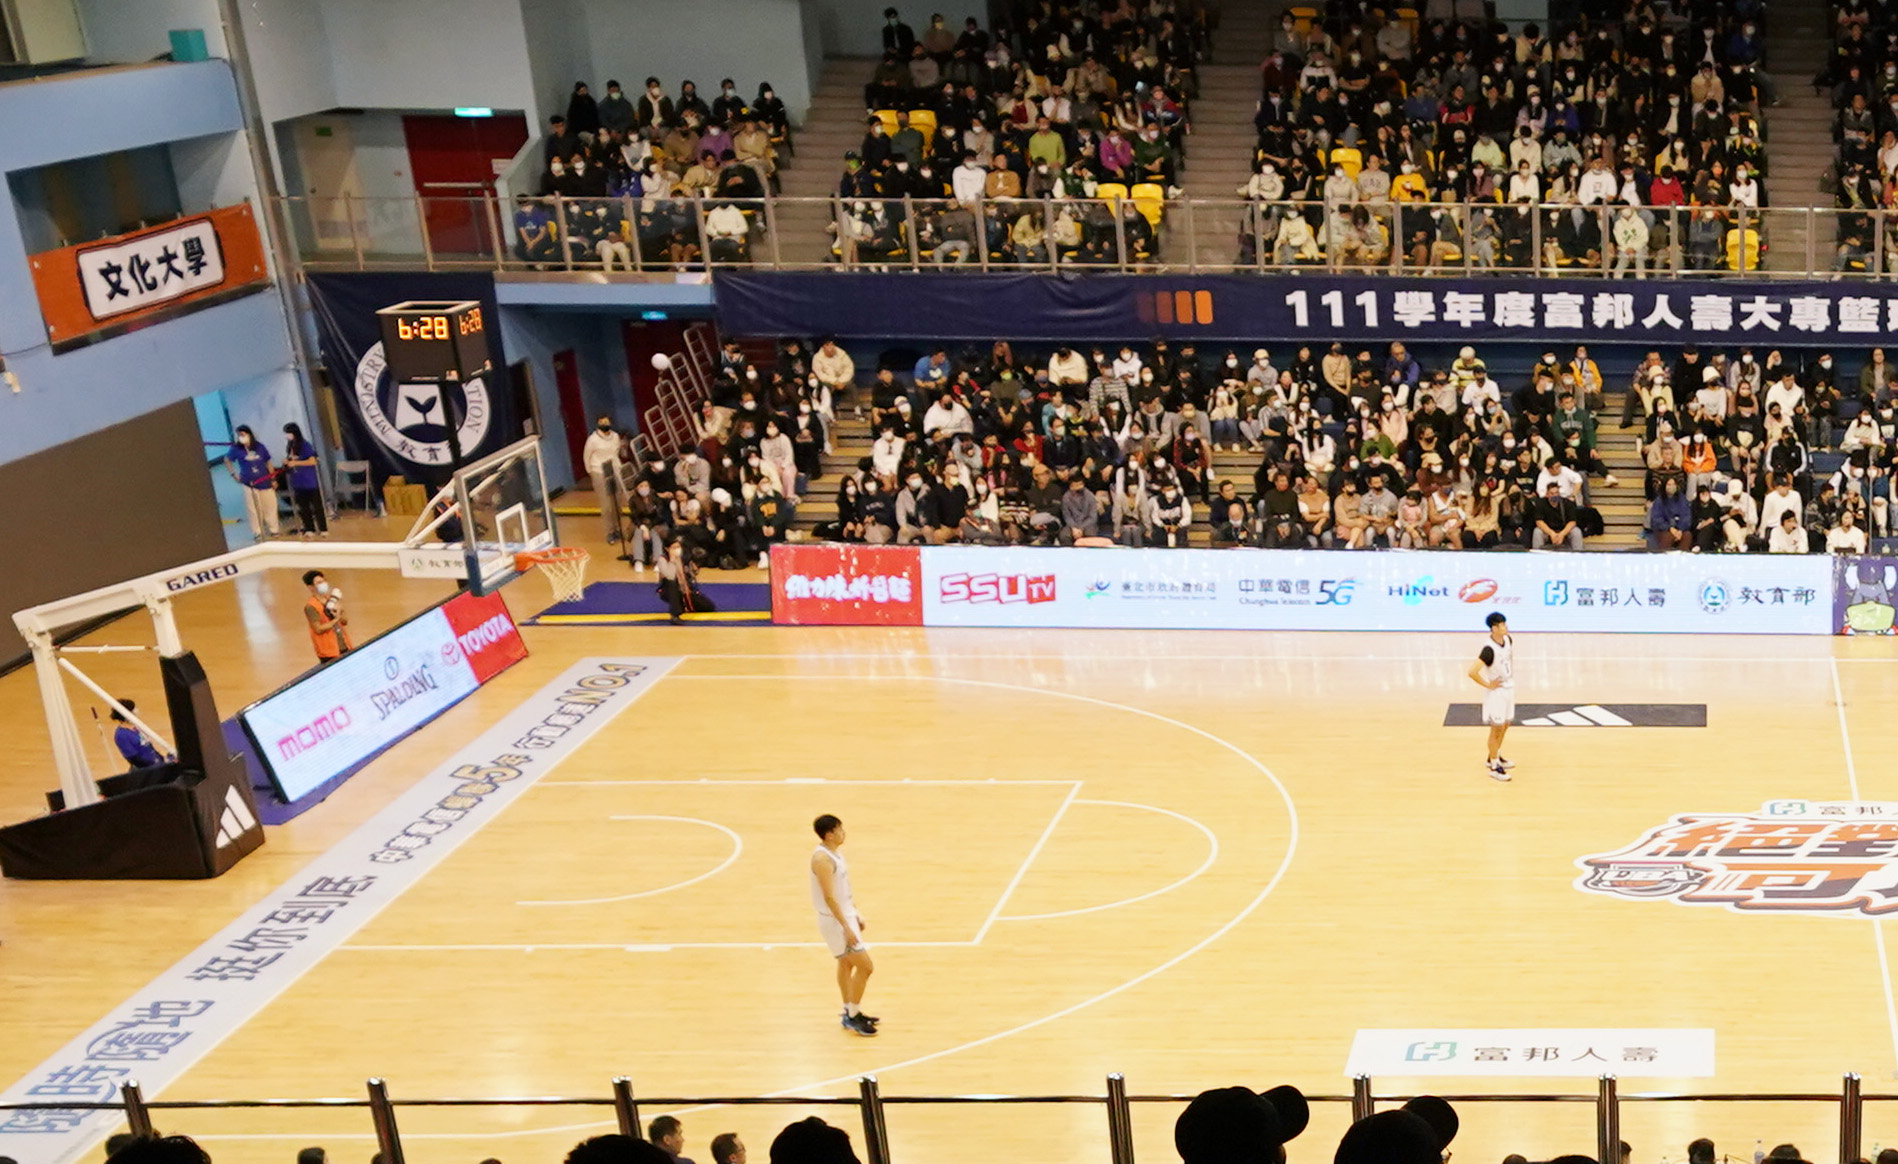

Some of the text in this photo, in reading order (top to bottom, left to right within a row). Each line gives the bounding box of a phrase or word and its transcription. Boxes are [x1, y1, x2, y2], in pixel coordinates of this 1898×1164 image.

[99, 231, 208, 300] 文化大學
[398, 316, 450, 340] 6:28
[459, 308, 483, 336] 6:28
[166, 563, 239, 592] GARED
[1238, 578, 1311, 595] 中華電信
[1315, 577, 1357, 606] 5G
[1388, 583, 1449, 597] HiNet
[1576, 587, 1666, 608] 富邦人壽
[1738, 586, 1816, 606] 教育部
[459, 611, 514, 657] TOYOTA
[370, 663, 438, 721] SPALDING
[185, 875, 378, 981] 挺你到底
[1473, 1044, 1660, 1064] 富邦人壽
